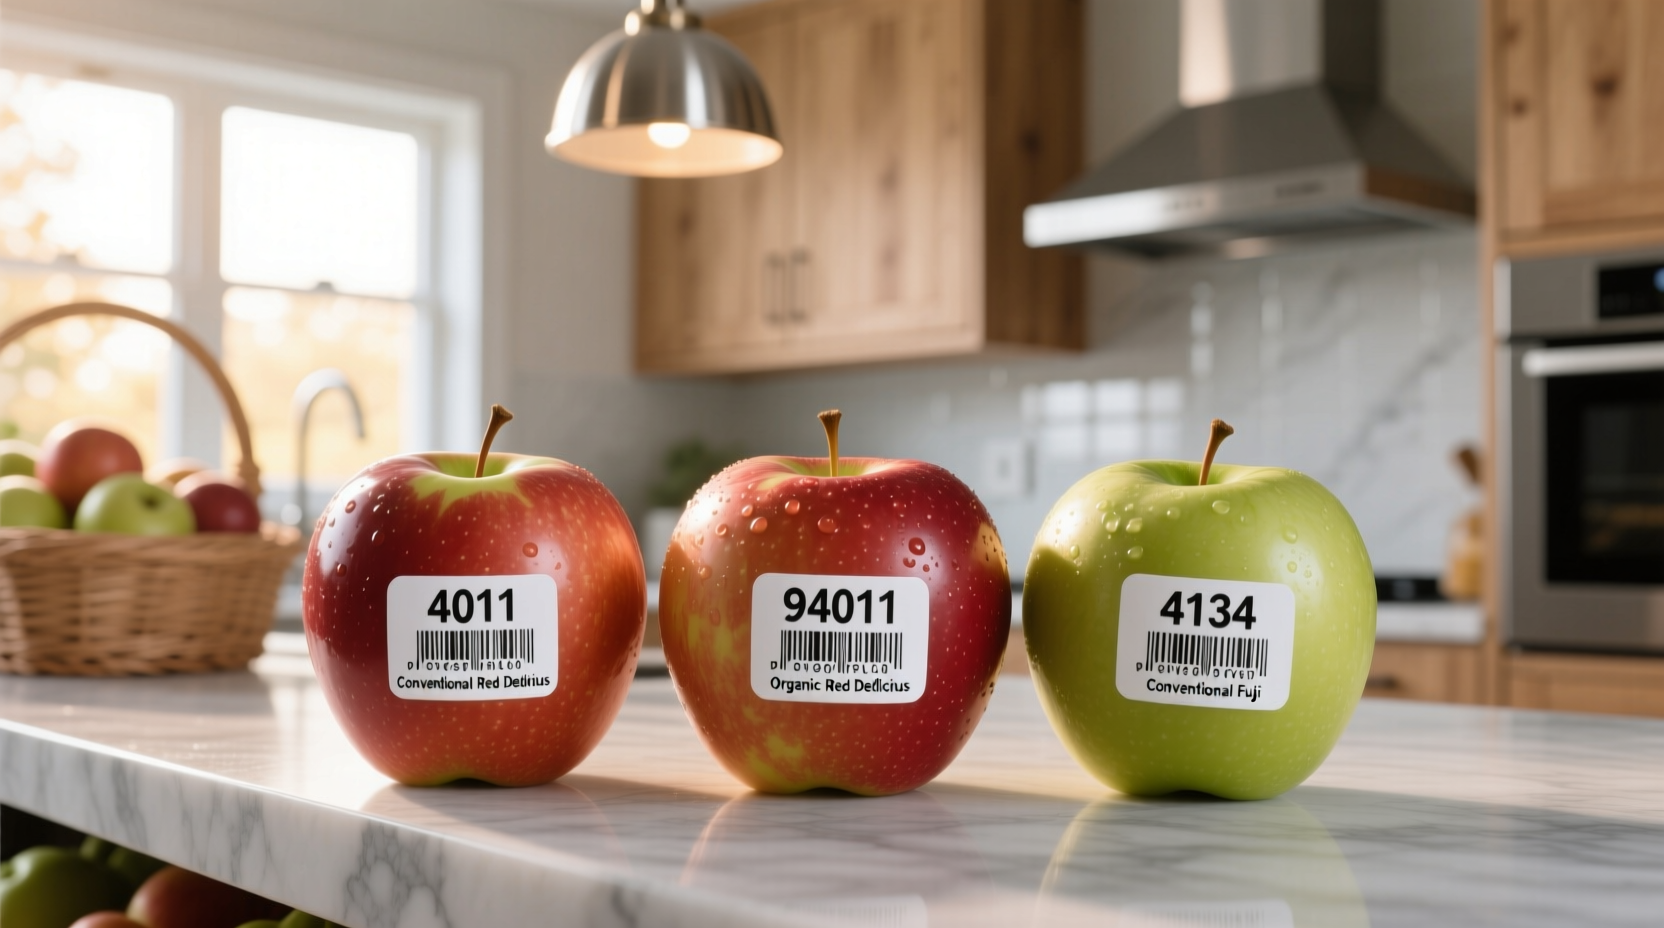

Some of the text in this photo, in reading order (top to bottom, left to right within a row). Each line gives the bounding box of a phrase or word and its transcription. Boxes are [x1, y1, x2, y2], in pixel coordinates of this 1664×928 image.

[428, 588, 514, 624] 4011
[783, 586, 895, 625] 94011
[1160, 591, 1257, 630] 4134
[397, 675, 473, 690] Conventional
[477, 676, 500, 690] Red
[770, 676, 822, 694] Organic
[825, 678, 851, 692] Red
[1146, 677, 1262, 703] Conventional Fuji
